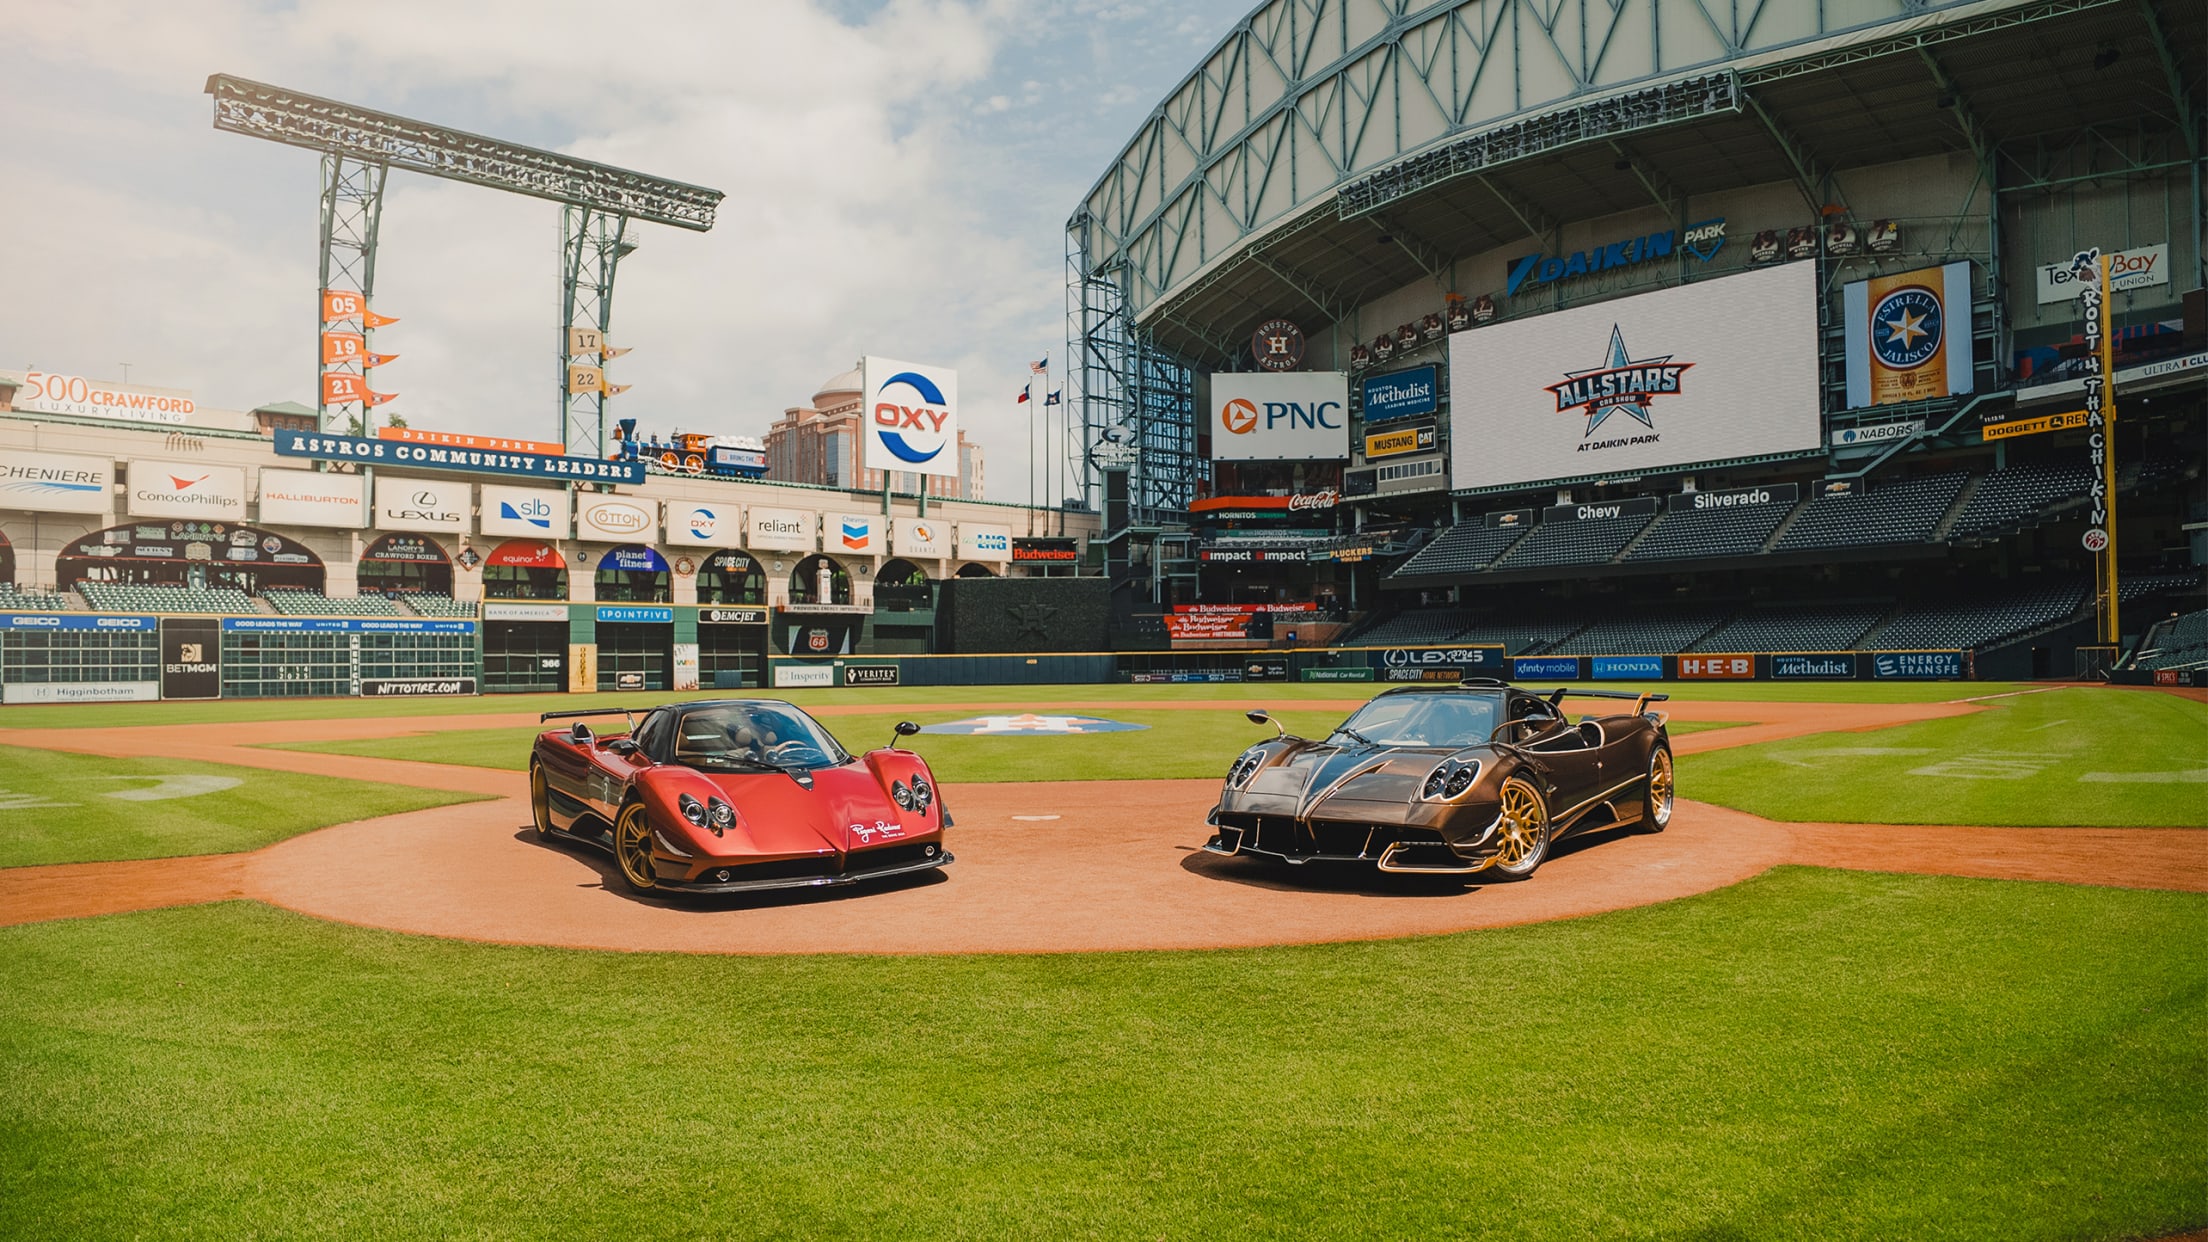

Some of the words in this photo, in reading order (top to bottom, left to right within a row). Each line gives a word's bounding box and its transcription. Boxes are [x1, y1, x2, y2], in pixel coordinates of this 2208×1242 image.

[1539, 229, 1675, 283] DAIKIN
[1684, 222, 1727, 244] PARK
[2045, 266, 2078, 285] Tex
[2114, 253, 2158, 274] Bay
[2120, 275, 2155, 289] UNION
[332, 297, 356, 313] 05
[1878, 294, 1936, 322] ESTRELLA
[2083, 290, 2101, 350] ROOT
[1258, 321, 1299, 337] HOUSTON
[334, 340, 356, 355] 19
[578, 334, 596, 348] 17
[1269, 336, 1289, 354] H
[1883, 342, 1934, 363] JALISCO
[1260, 355, 1297, 369] ASTROS
[2085, 356, 2099, 372] 4
[2144, 361, 2180, 376] ULTRA
[332, 379, 354, 394] 21
[577, 373, 595, 386] 22
[24, 372, 88, 403] 500
[90, 390, 195, 415] CRAWFORD
[1368, 385, 1393, 394] HOUSTON
[1368, 382, 1430, 406] Methodist
[1616, 395, 1636, 403] SHOW
[2086, 380, 2103, 427] THA
[39, 402, 110, 417] LUXURY
[120, 408, 182, 423] LIVING
[875, 402, 949, 433] OXY
[1262, 401, 1342, 430] PNC
[1860, 424, 1914, 440] NABORS
[1988, 420, 2047, 437] DOGGETT
[402, 430, 475, 445] DAIKIN
[490, 439, 535, 451] PARK
[1374, 435, 1413, 450] MUSTANG
[1418, 432, 1433, 444] CAT
[1577, 443, 1591, 452] AT
[1592, 438, 1628, 450] DAIKIN
[1630, 433, 1660, 446] PARK
[292, 436, 385, 458] ASTROS
[395, 446, 535, 470] COMMUNITY
[544, 459, 633, 479] LEADERS
[0, 464, 103, 485] CHENIERE
[2089, 433, 2106, 525] CHIKIN
[137, 490, 239, 508] ConocoPhillips
[266, 492, 359, 505] HALLIBURTON
[1694, 488, 1771, 509] Silverado
[520, 498, 551, 517] slb
[1577, 505, 1621, 520] Chevy
[387, 508, 460, 522] LEXUS
[594, 509, 641, 529] COTTON
[842, 515, 869, 524] Chevron
[690, 520, 716, 528] OXY
[758, 519, 801, 534] reliant
[977, 533, 1007, 551] LNG
[375, 551, 415, 560] CRAWFORD
[416, 553, 438, 561] BOXES
[503, 555, 534, 564] equinor
[615, 550, 647, 561] planet
[1013, 548, 1077, 560] Budweiser
[1209, 551, 1252, 562] impact
[1264, 551, 1306, 562] impact
[1329, 547, 1373, 558] PLUCKERS
[619, 559, 653, 569] fitness
[714, 556, 736, 568] SPACE
[736, 557, 750, 568] CITY
[1200, 604, 1242, 612] Budweiser
[1267, 603, 1305, 612] Budweiser
[12, 617, 61, 626] GEICO
[97, 617, 142, 627] GEICO
[601, 610, 669, 620] 1POINTFIVE
[720, 611, 757, 623] EMCJET
[812, 637, 825, 647] 66
[541, 659, 561, 668] 366
[676, 658, 696, 666] WM
[1682, 659, 1750, 674] H-E-B
[1899, 654, 1953, 665] ENERGY
[166, 663, 217, 673] BETMGM
[857, 669, 896, 678] VERITEX
[1517, 662, 1545, 674] xfinity
[1546, 662, 1576, 674] mobile
[1606, 663, 1661, 673] HONDA
[1778, 659, 1848, 675] Methodist
[790, 670, 830, 682] Insperity
[1389, 668, 1409, 680] SPACE
[1409, 668, 1423, 680] CITY
[1437, 671, 1461, 681] NETWORK
[57, 687, 134, 697] Higginbotham
[377, 681, 461, 695] NITTOTIRE.COM
